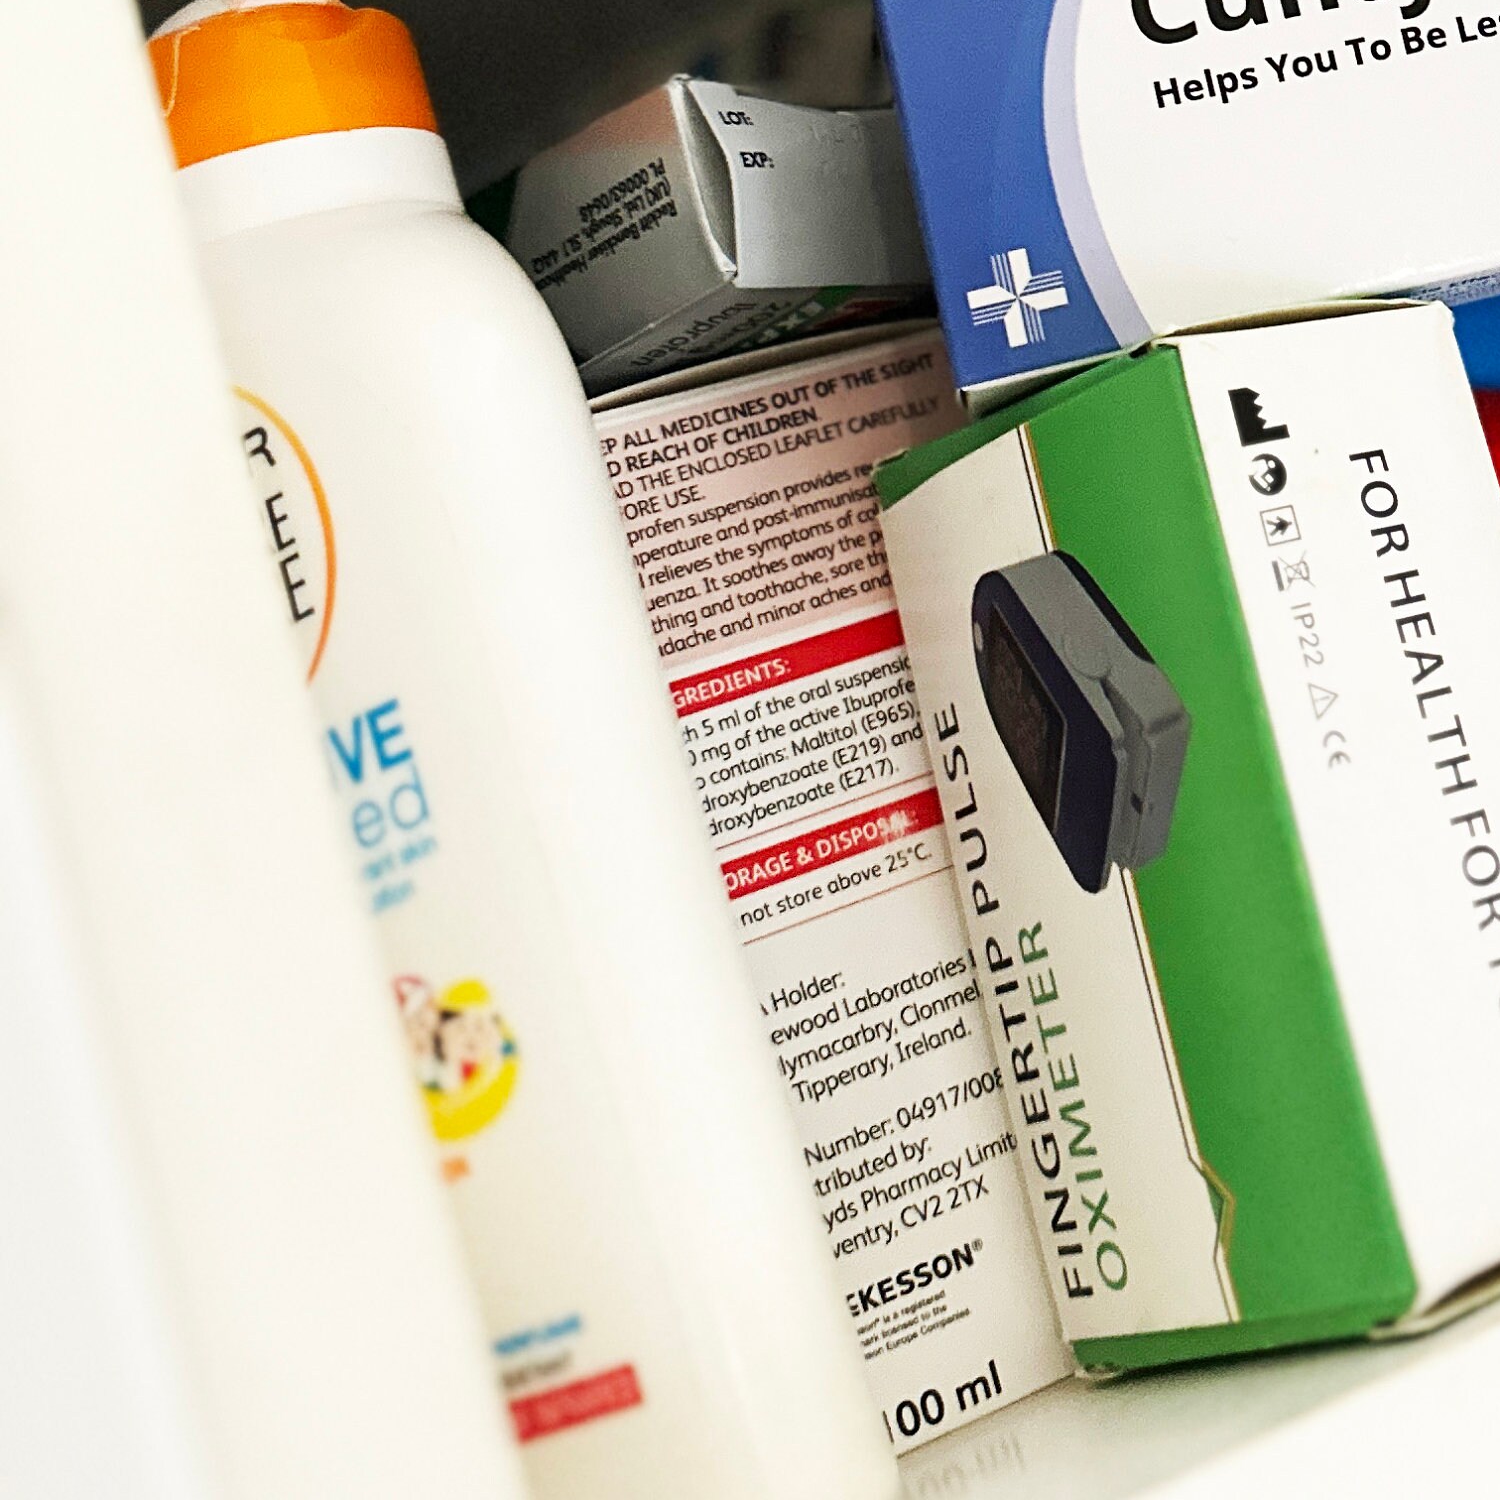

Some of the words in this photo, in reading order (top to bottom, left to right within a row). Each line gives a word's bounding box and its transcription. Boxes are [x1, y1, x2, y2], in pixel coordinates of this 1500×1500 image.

[1153, 66, 1259, 109] Helps
[1264, 49, 1339, 83] You
[1344, 36, 1392, 66] To
[1399, 25, 1448, 56] Be
[717, 109, 754, 128] LOT:
[739, 150, 775, 171] EXP:
[621, 427, 660, 452] ALL
[658, 396, 770, 441] MEDICINES
[769, 384, 810, 410] OUT
[812, 376, 838, 399] OF
[839, 367, 879, 390] THE
[879, 353, 932, 381] SIGHT
[622, 440, 692, 473] REACH
[691, 432, 719, 454] OF
[721, 406, 822, 446] CHILDREN.
[1288, 602, 1328, 668] IP22
[1348, 448, 1410, 558] FOR
[1383, 568, 1479, 796] HEALTH
[672, 657, 792, 710] GREDIENTS:
[700, 717, 715, 737] 5
[717, 708, 742, 732] ml
[743, 700, 762, 723] of
[765, 695, 797, 716] the
[798, 678, 833, 705] oral
[700, 741, 733, 763] mg
[733, 728, 752, 752] of
[754, 723, 787, 745] the
[788, 704, 841, 733] active
[841, 675, 916, 716] Ibuprofe
[701, 758, 830, 815] droxybenzoate
[831, 734, 888, 770] (E219)
[889, 720, 923, 748] and
[708, 747, 790, 785] contains:
[790, 719, 859, 757] Maltitol
[860, 697, 921, 735] (E965),
[707, 781, 836, 838] droxybenzoate
[837, 756, 900, 793] (E217).
[933, 702, 1001, 917] PULSE
[724, 851, 794, 892] ORAGE
[795, 845, 815, 866] &
[739, 902, 774, 928] not
[775, 885, 824, 915] store
[826, 864, 883, 895] above
[883, 842, 933, 874] 25°C.
[768, 1001, 841, 1047] ewood
[840, 955, 968, 1020] Laboratories
[769, 971, 846, 1013] Holder:
[776, 1017, 899, 1083] lymacarbry,
[790, 1051, 895, 1104] Tipperary,
[893, 1017, 973, 1064] Ireland.
[802, 1117, 896, 1168] Number:
[985, 936, 1095, 1299] FINGERTIP
[1019, 920, 1128, 1291] OXIMETER
[812, 1144, 899, 1198] tributed
[899, 1136, 932, 1163] by:
[821, 1200, 859, 1236] yds
[859, 1155, 962, 1214] Pharmacy
[964, 1128, 1018, 1169] Limit
[832, 1219, 899, 1261] ventry,
[899, 1194, 945, 1230] CV2
[945, 1174, 990, 1210] 2TX
[956, 1358, 1003, 1413] ml
